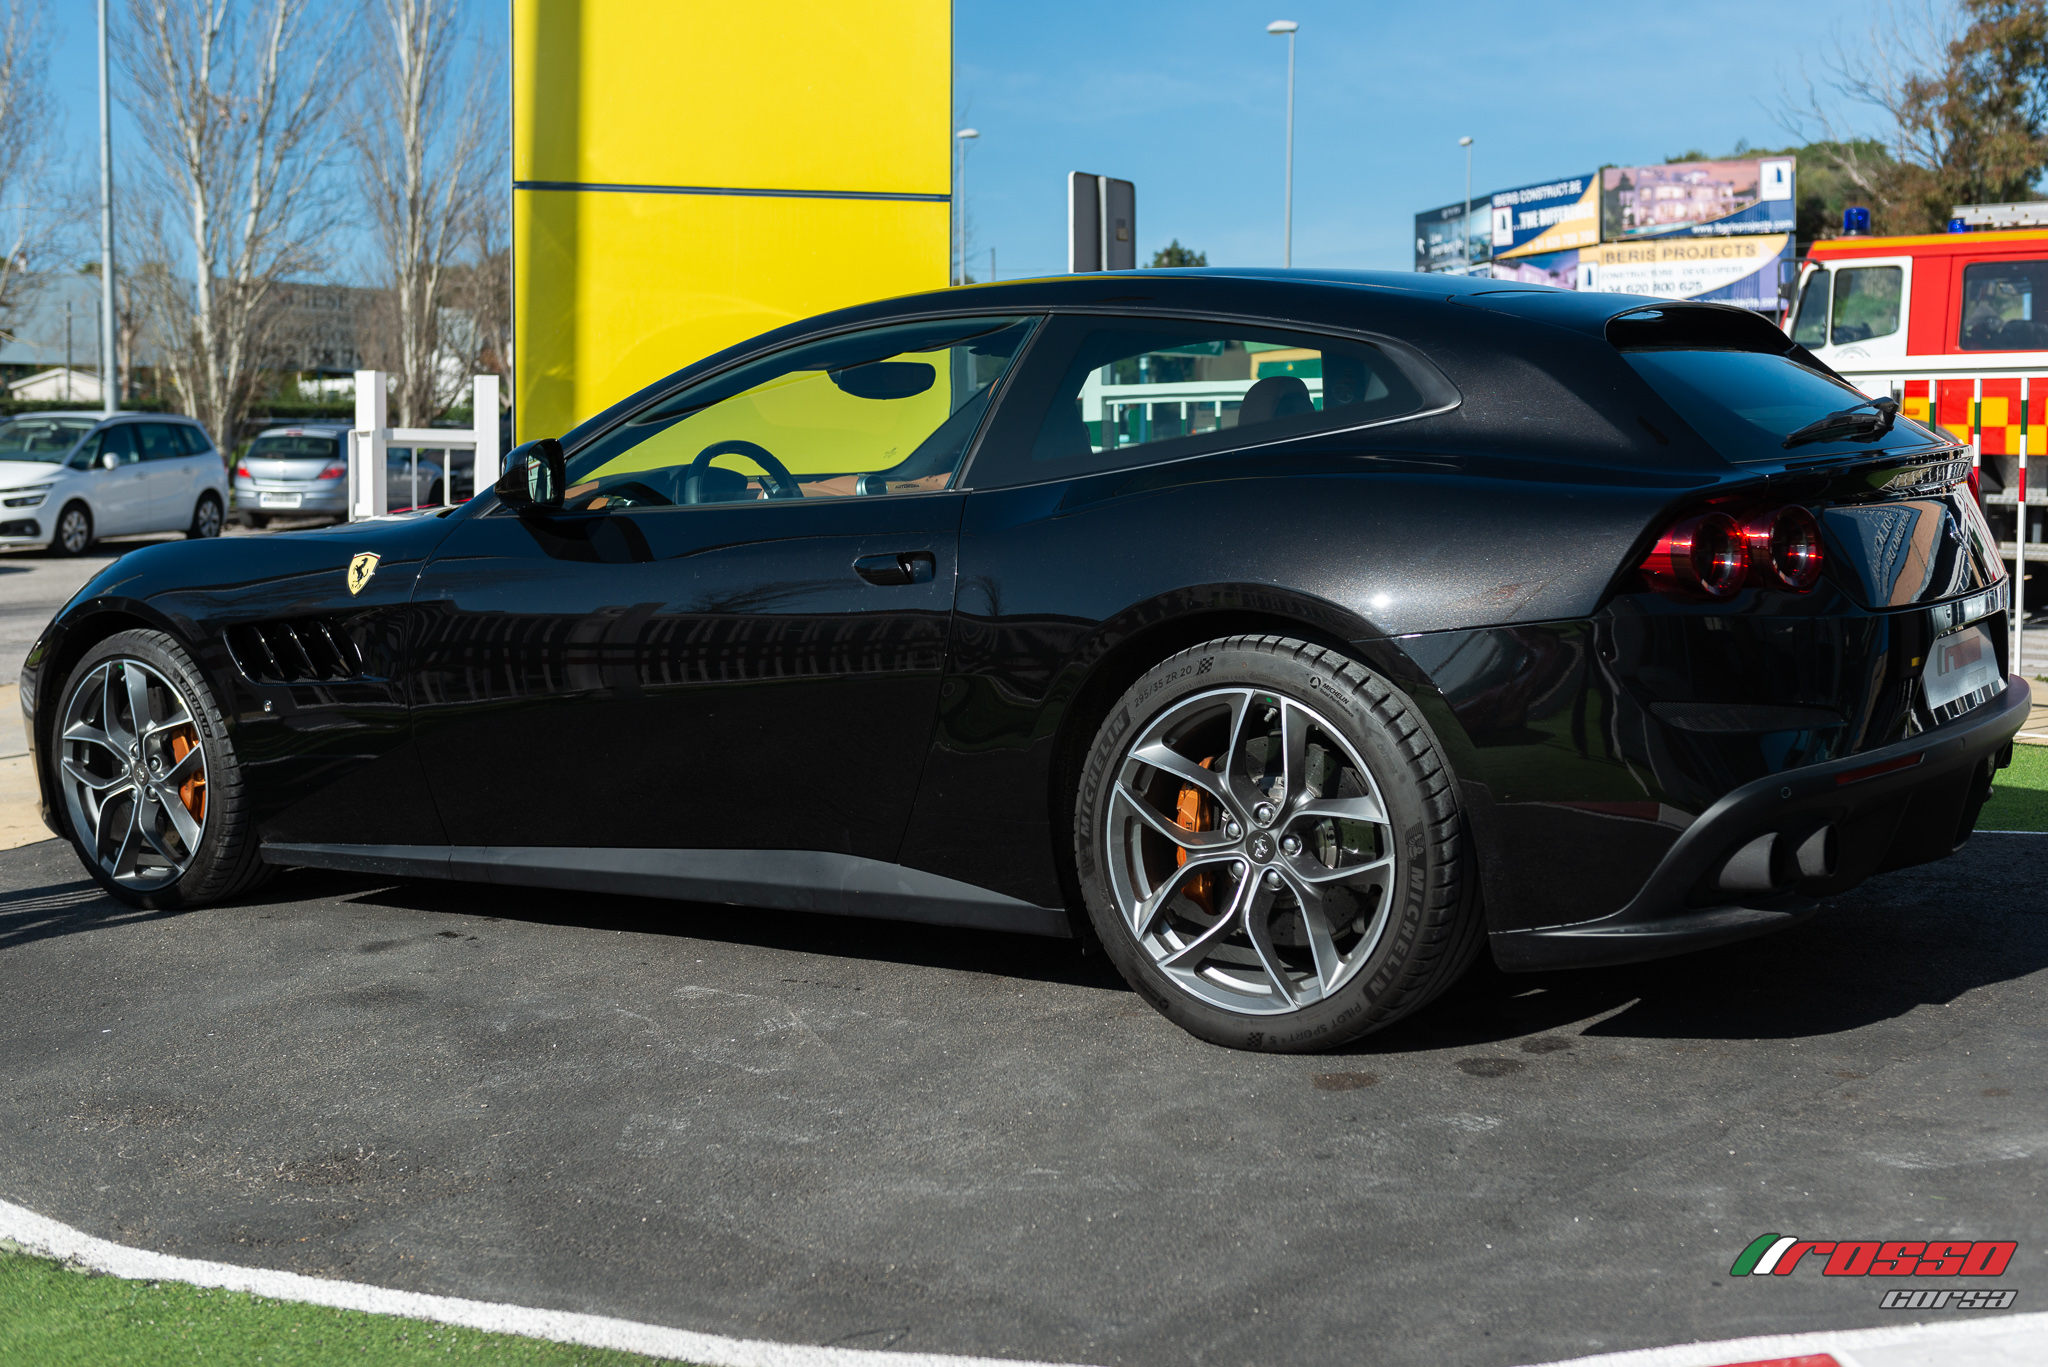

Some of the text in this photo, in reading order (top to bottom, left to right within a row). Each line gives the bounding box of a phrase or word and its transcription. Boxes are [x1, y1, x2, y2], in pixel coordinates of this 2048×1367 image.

[1663, 243, 1757, 260] PROJECTS
[1134, 665, 1192, 708] 295/35 ZR 20
[1322, 682, 1350, 705] MICHELIN
[181, 681, 211, 736] MICHELIN
[1319, 687, 1330, 699] Total
[1329, 694, 1354, 718] Performance
[1080, 713, 1126, 839] MICHELIN
[1370, 866, 1425, 996] MICHELIN
[1331, 1002, 1362, 1028] PILOT
[1290, 1023, 1328, 1041] SPORT
